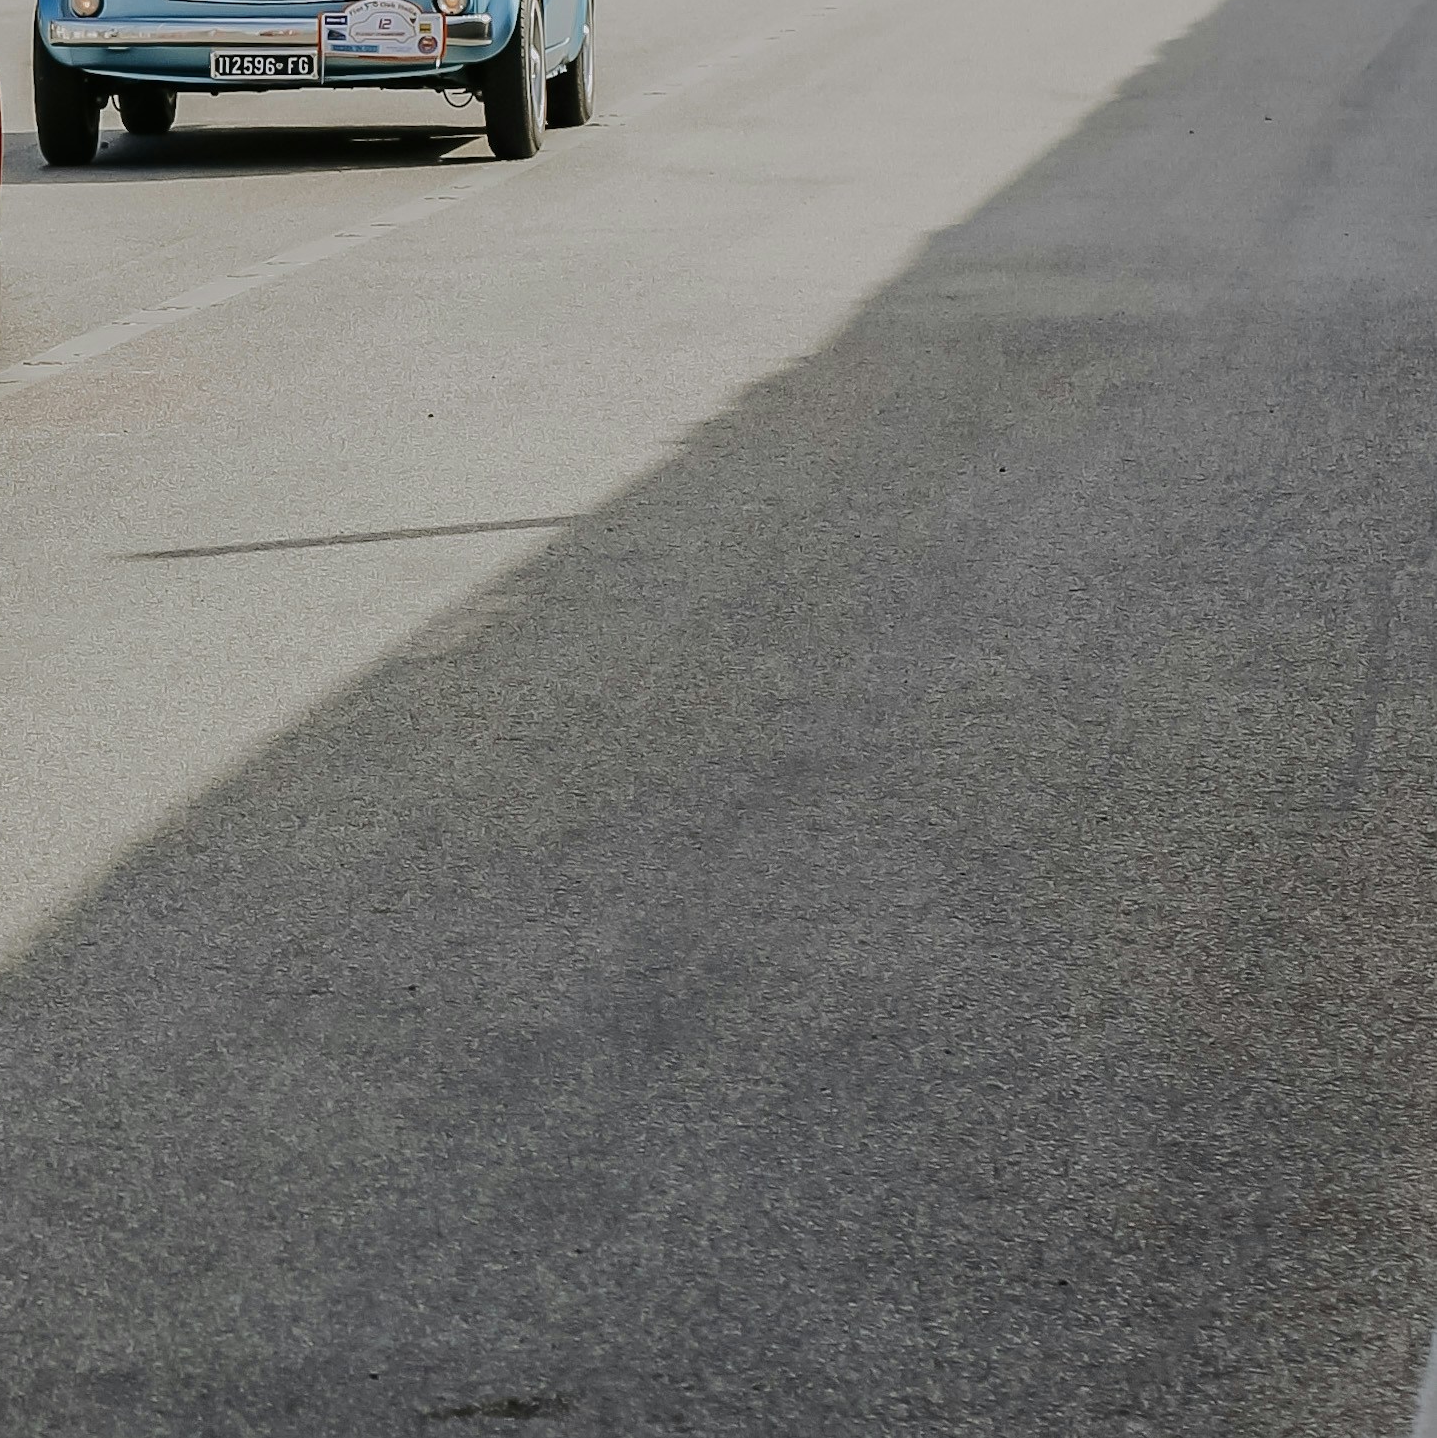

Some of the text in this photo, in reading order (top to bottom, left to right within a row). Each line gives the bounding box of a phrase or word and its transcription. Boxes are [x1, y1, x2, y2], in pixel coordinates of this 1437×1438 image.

[378, 18, 392, 29] 12
[217, 56, 309, 75] 112596 FG
